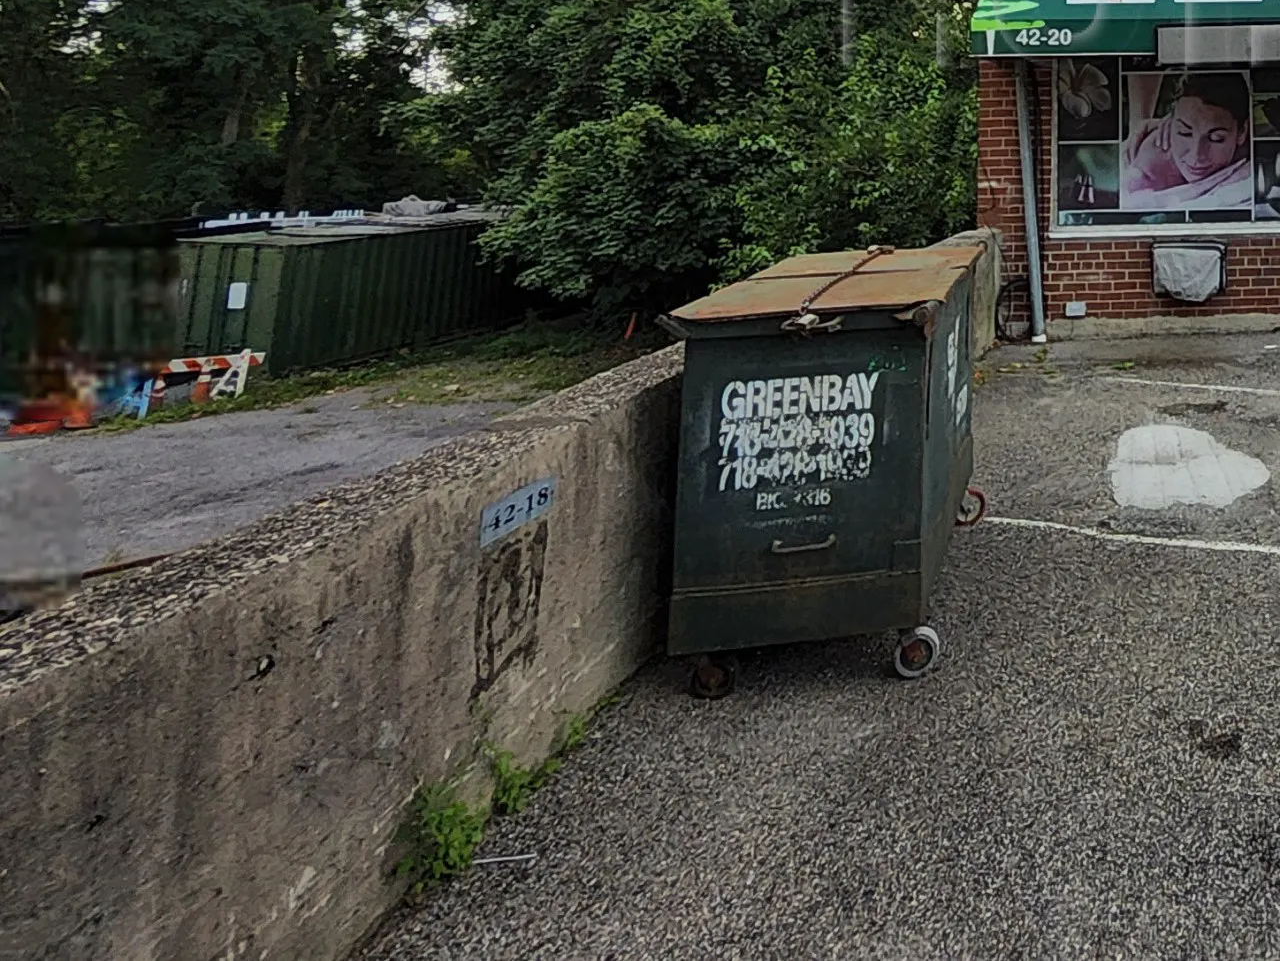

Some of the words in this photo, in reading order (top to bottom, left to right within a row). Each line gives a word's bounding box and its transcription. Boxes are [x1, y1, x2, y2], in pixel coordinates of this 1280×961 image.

[1015, 28, 1072, 46] 42-20
[721, 372, 879, 420] GREENBAY
[487, 485, 550, 532] 42-18
